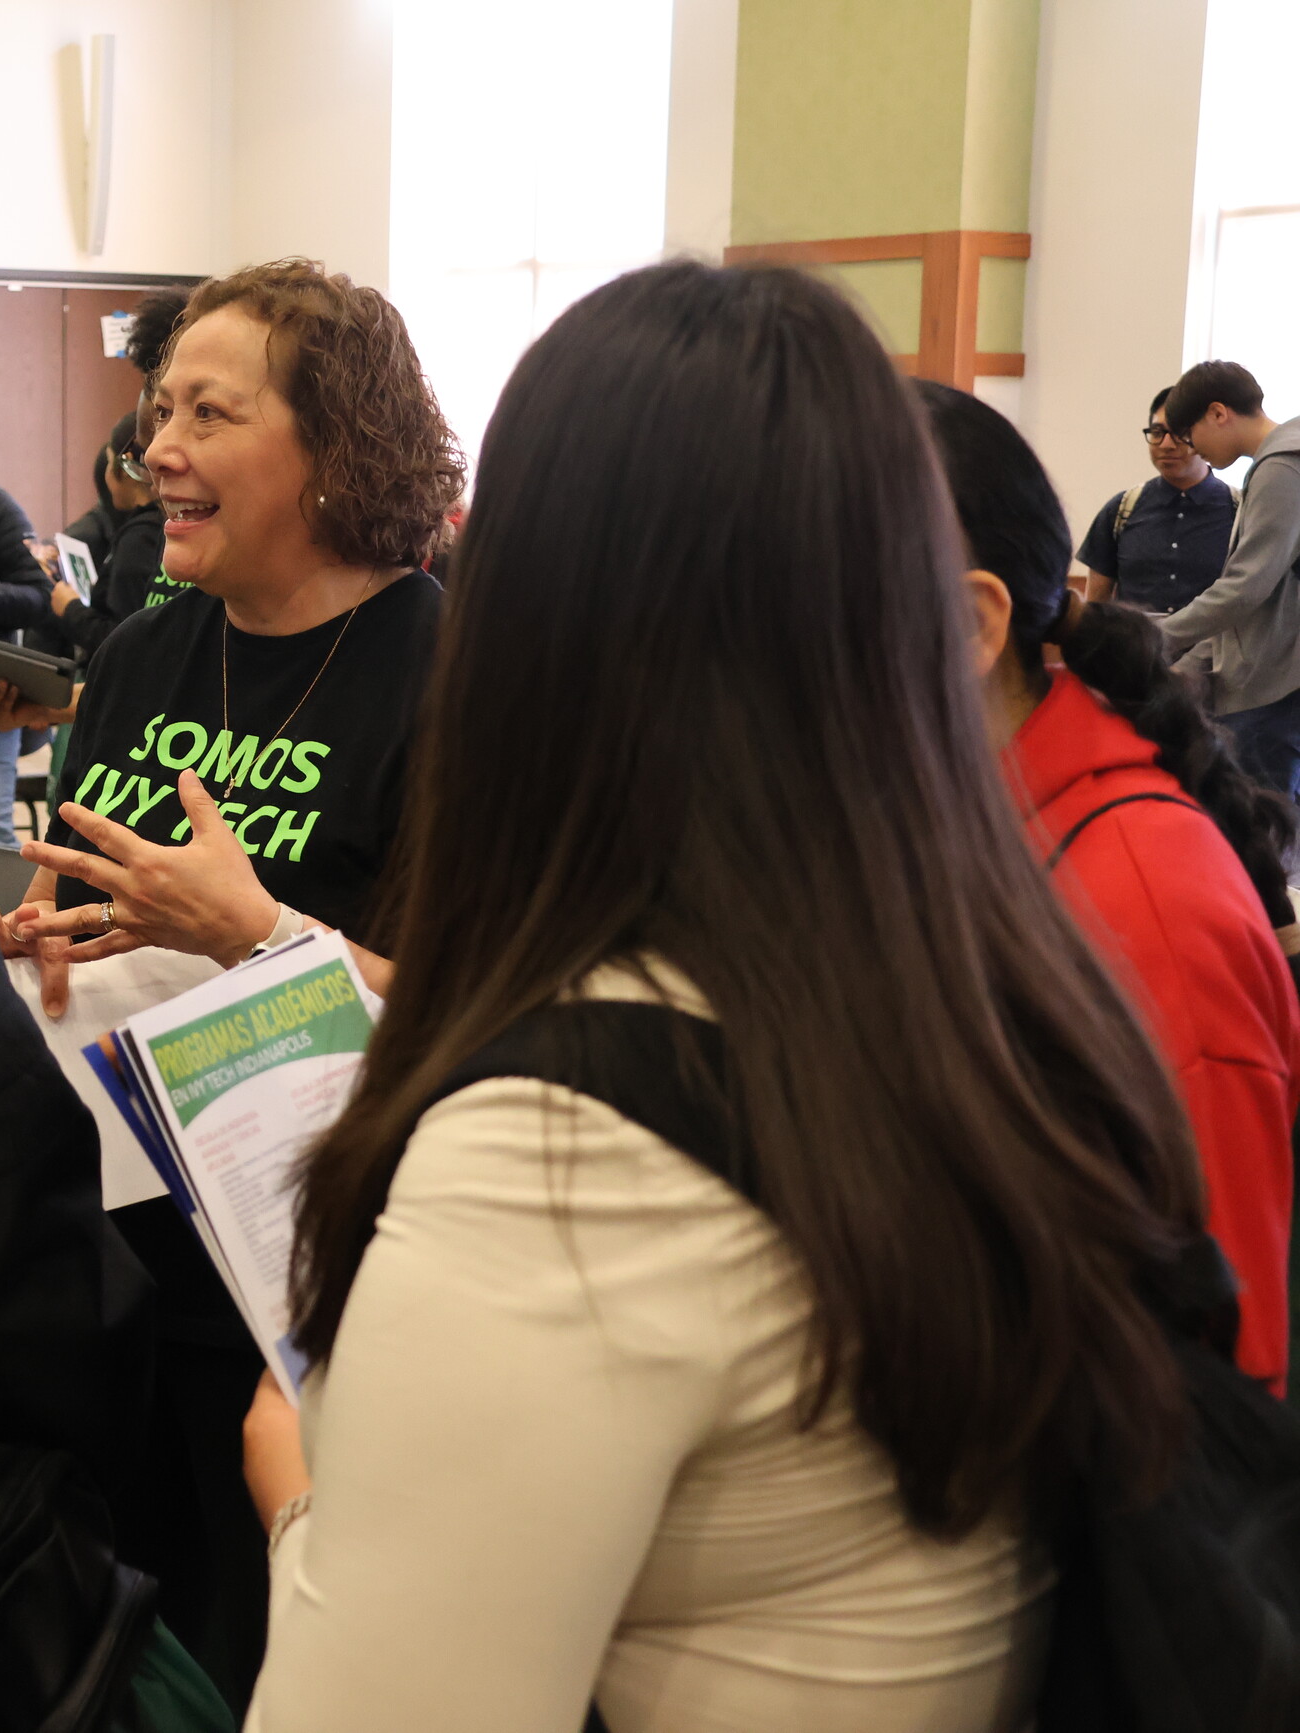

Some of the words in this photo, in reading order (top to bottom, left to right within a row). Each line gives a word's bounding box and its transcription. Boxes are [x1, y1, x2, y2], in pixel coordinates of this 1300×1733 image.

[128, 713, 332, 794] SOMOS
[74, 762, 176, 828] IVY
[154, 1012, 254, 1086] PROGRAMAS
[249, 969, 356, 1042] ACADÉMICOS
[170, 1087, 190, 1108] EN
[204, 1064, 237, 1090] TECH
[232, 1028, 314, 1079] INDIANAPOLIS
